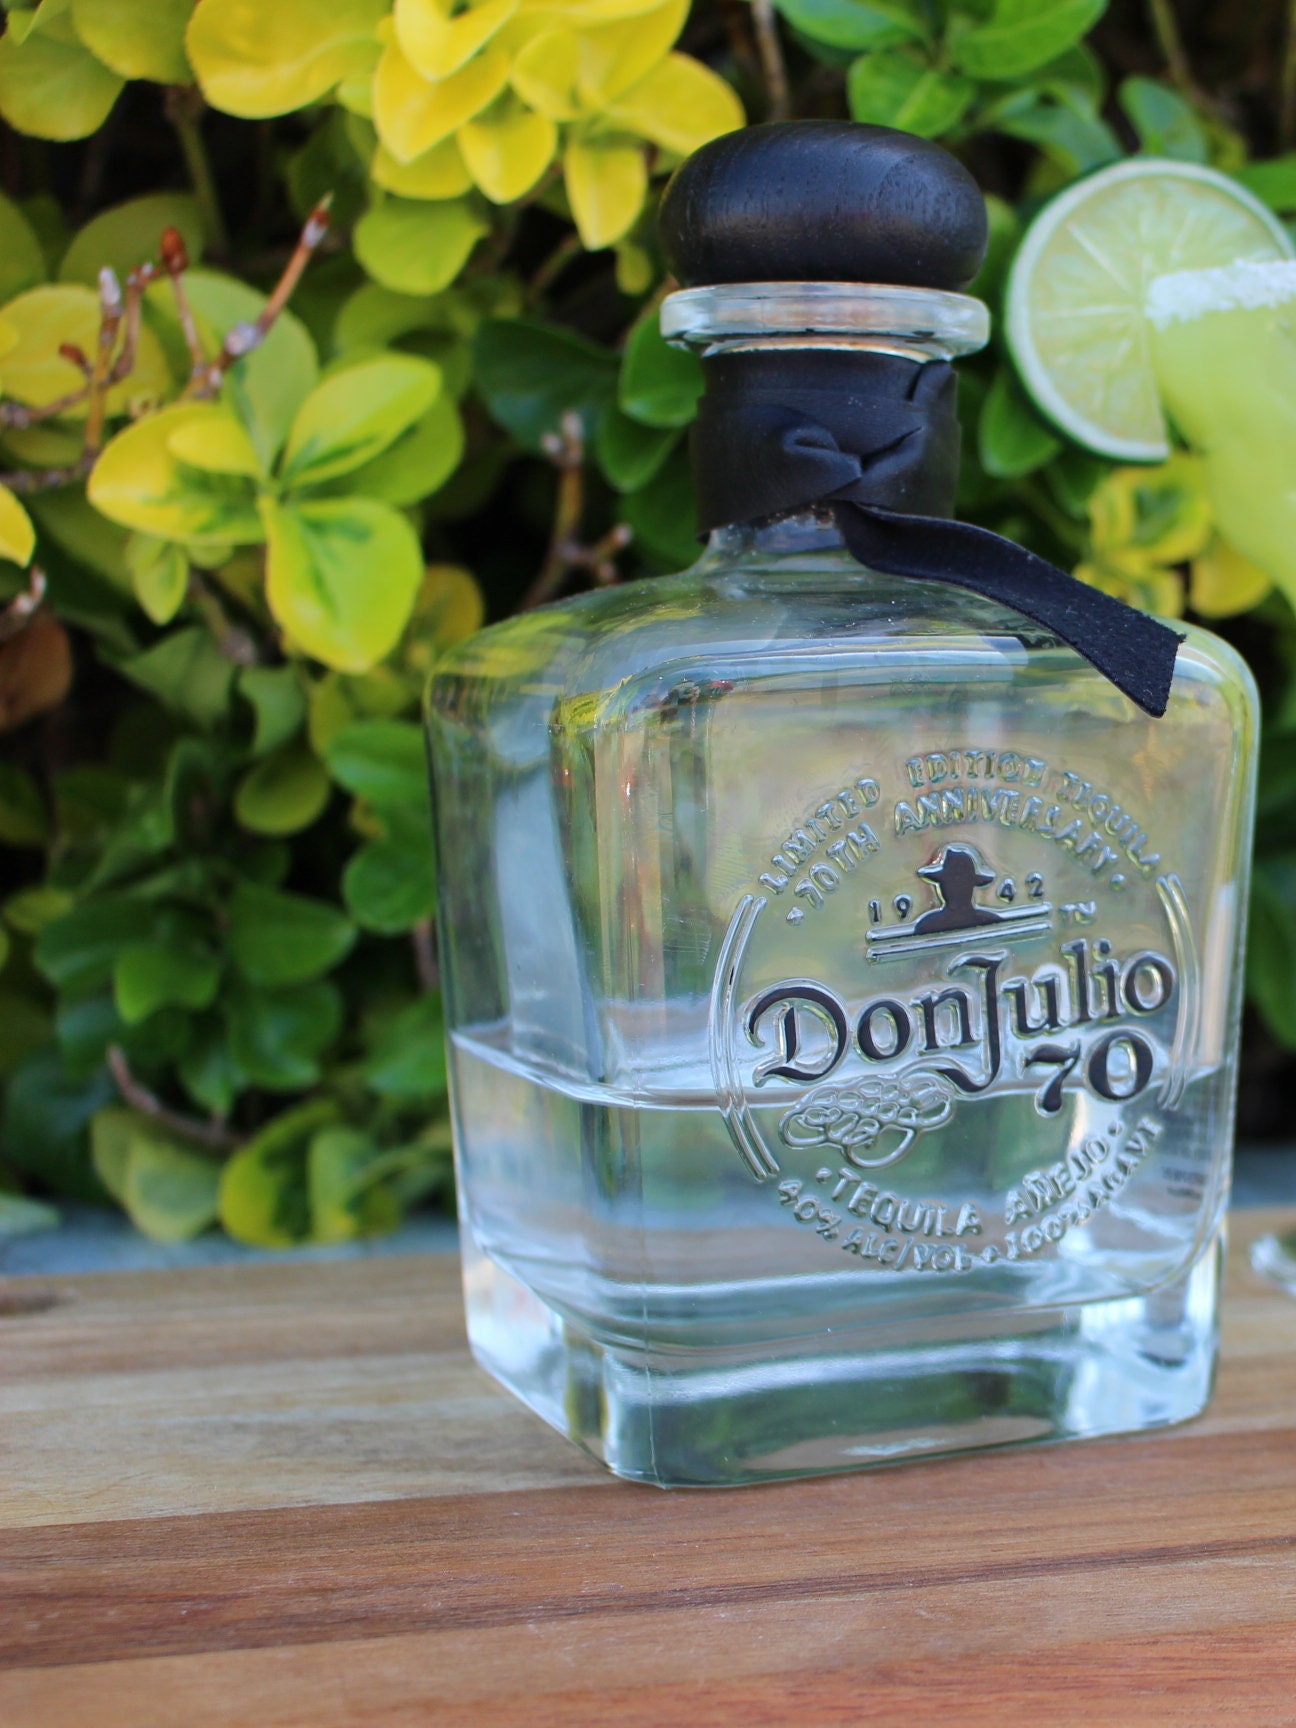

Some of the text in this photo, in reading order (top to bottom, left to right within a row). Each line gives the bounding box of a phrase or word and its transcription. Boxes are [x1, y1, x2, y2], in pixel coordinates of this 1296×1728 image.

[757, 776, 882, 895] LIMITED
[793, 821, 882, 910] 70TH
[1019, 1027, 1156, 1118] 70
[831, 1166, 984, 1237] TEQUILA
